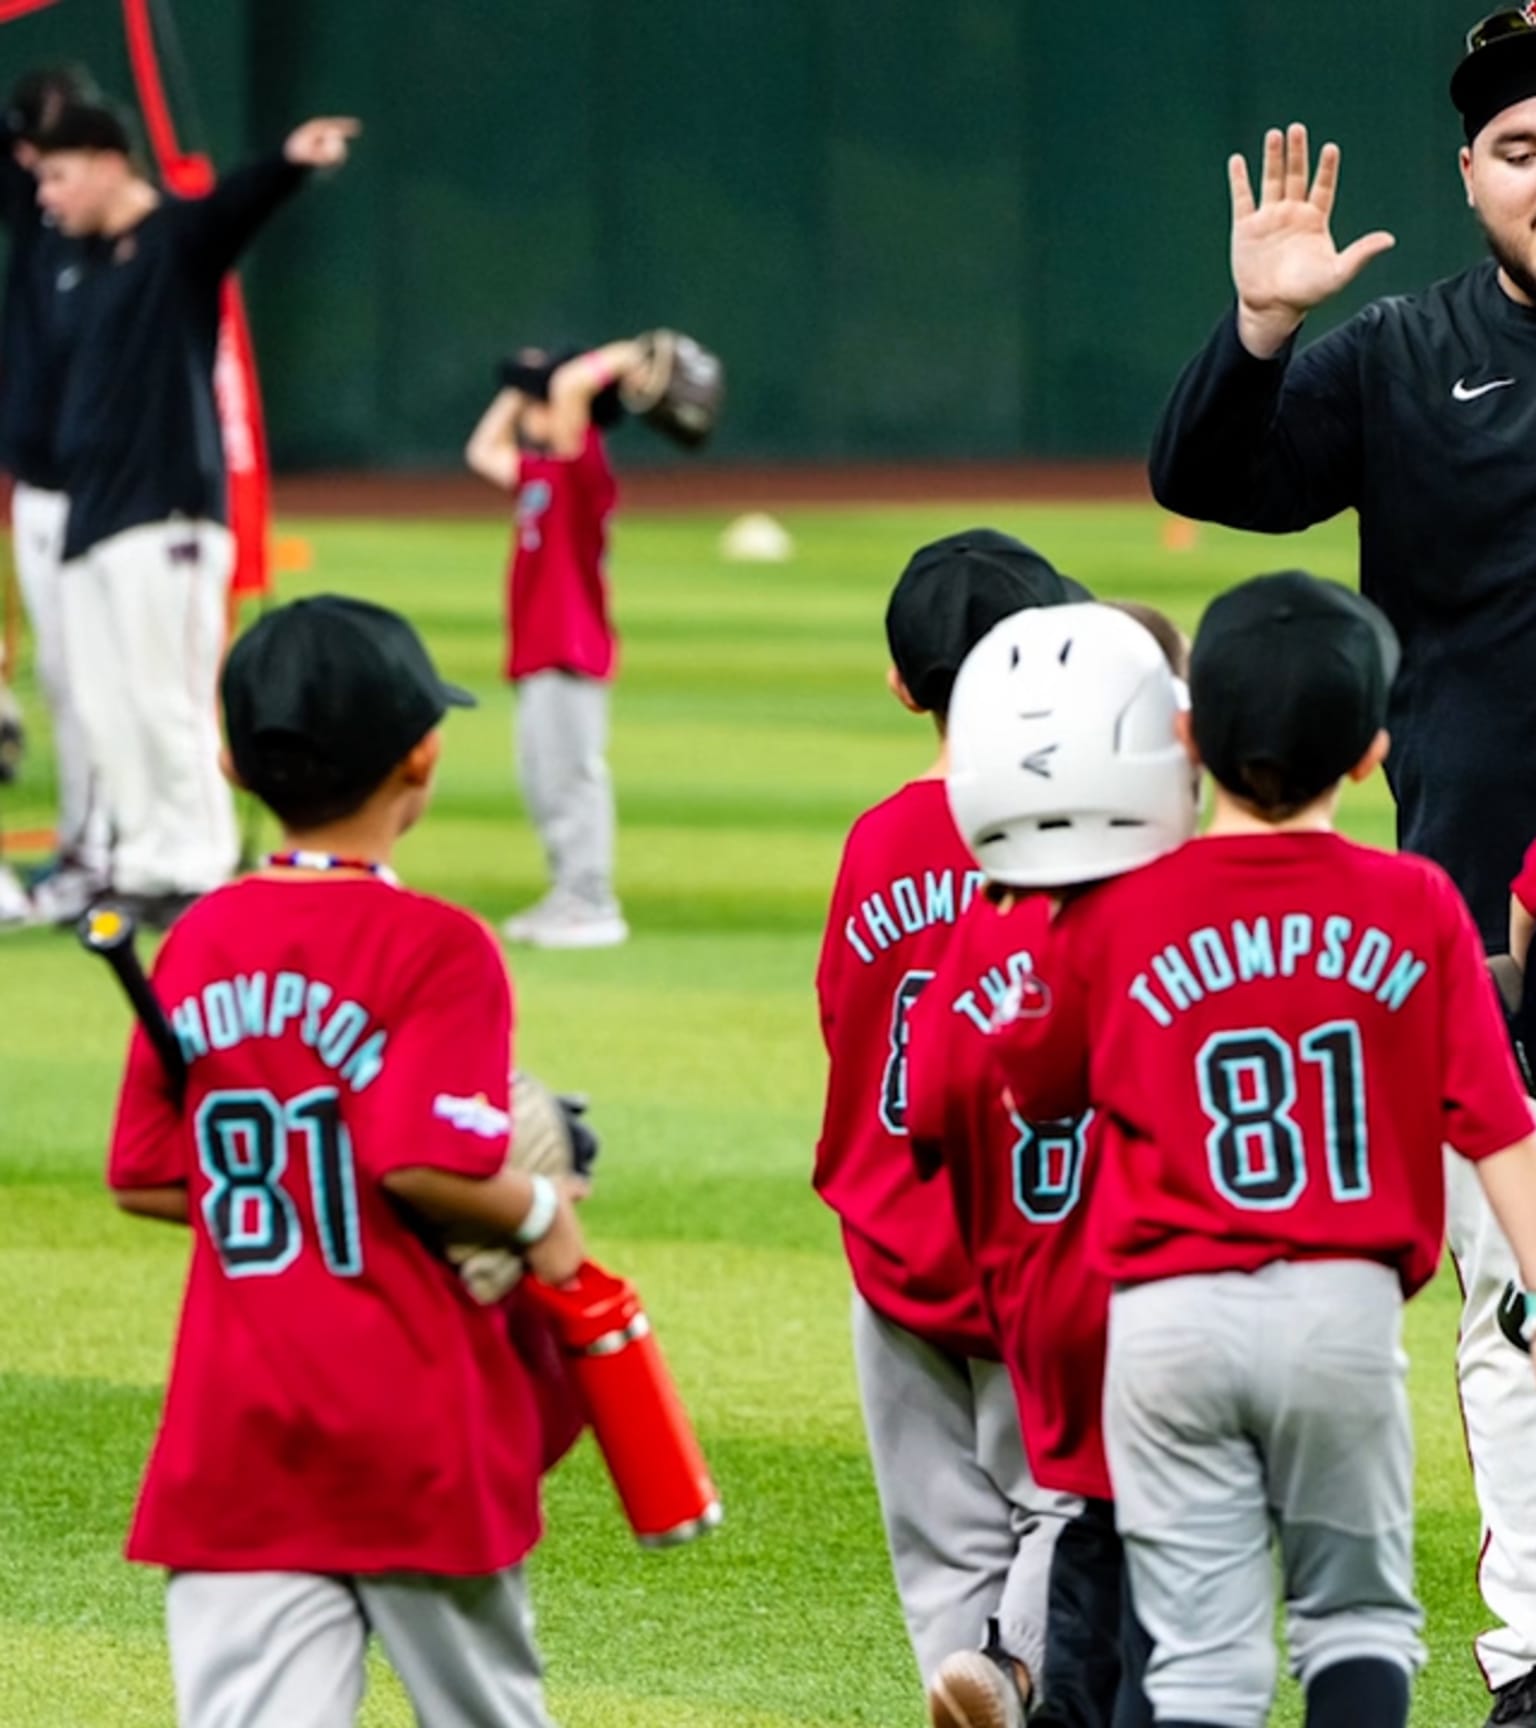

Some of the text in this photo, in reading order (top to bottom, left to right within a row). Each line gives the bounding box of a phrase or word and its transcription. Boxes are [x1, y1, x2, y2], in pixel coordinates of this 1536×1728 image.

[844, 868, 986, 964] THOMP
[1129, 913, 1427, 1027] THOMPSON
[171, 970, 387, 1092] HOMPSON
[1195, 1019, 1371, 1211] 81
[194, 1086, 363, 1278] 81
